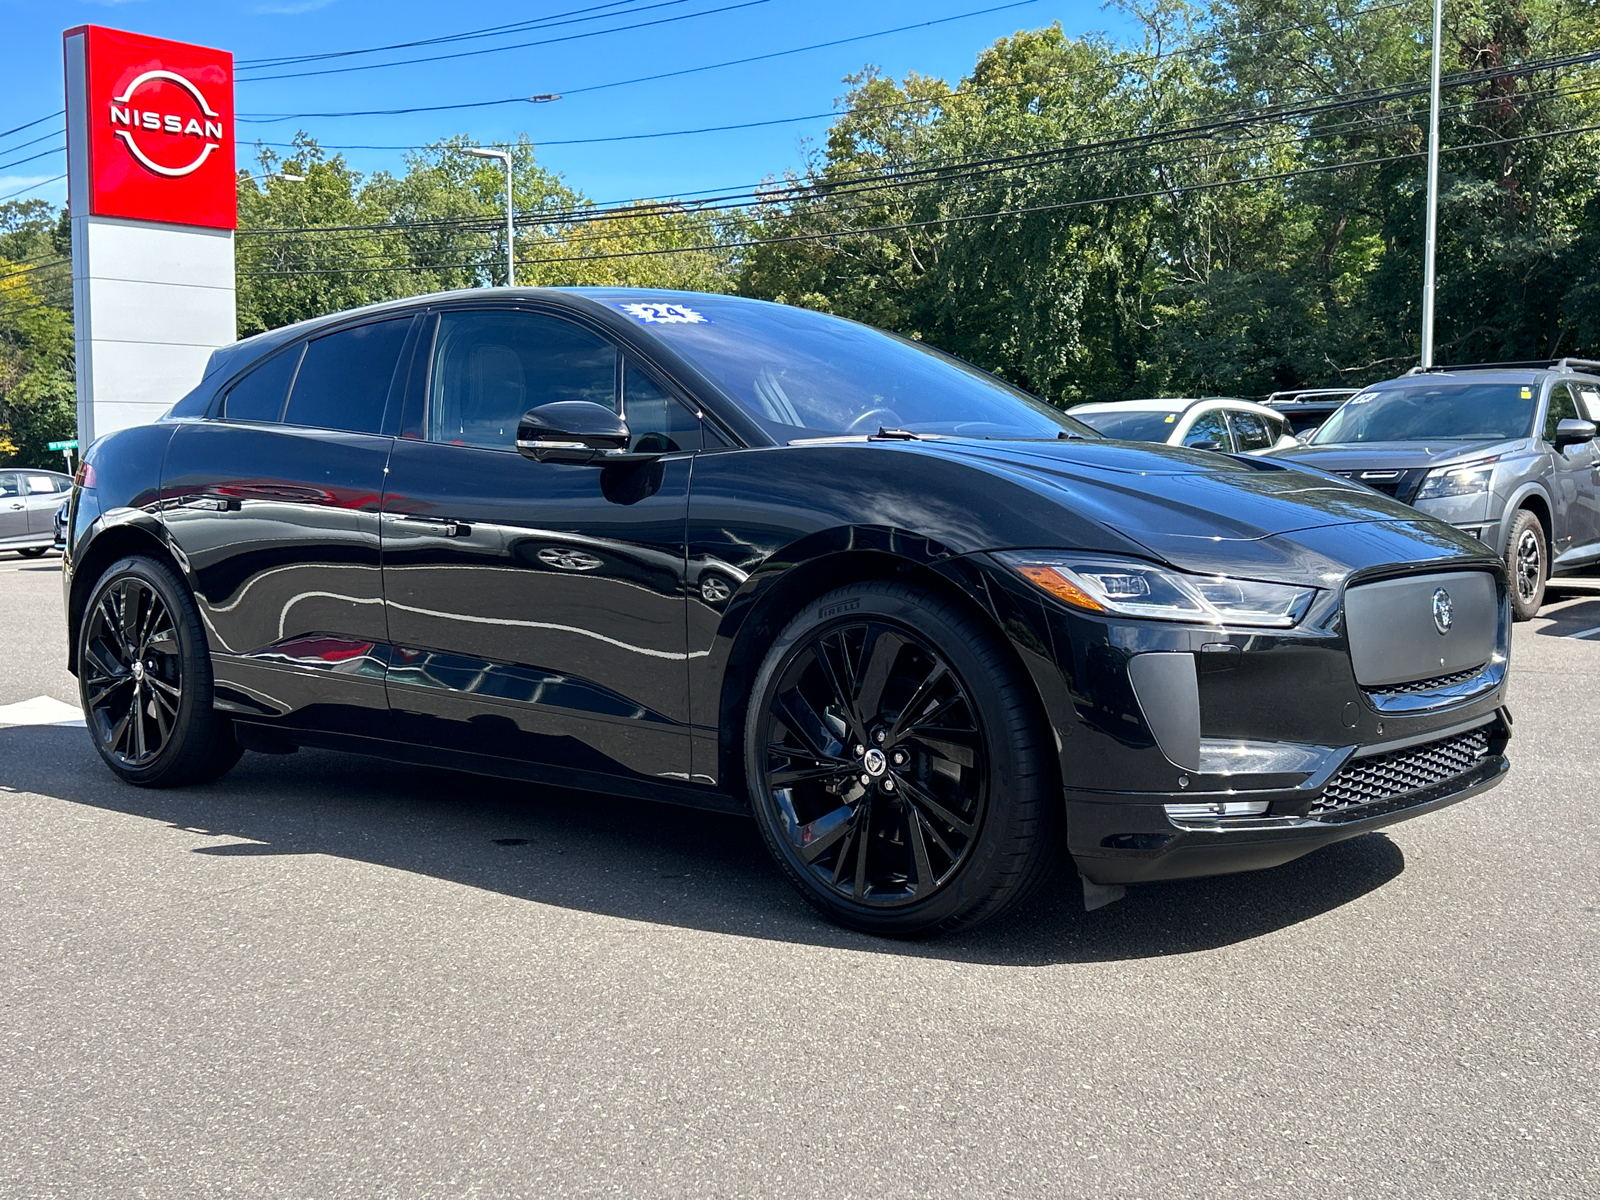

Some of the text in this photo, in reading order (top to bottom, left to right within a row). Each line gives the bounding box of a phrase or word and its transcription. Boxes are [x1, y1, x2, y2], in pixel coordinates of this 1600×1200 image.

[110, 106, 223, 139] NISSAN
[641, 306, 687, 319] 24
[818, 597, 861, 619] PIRELLI
